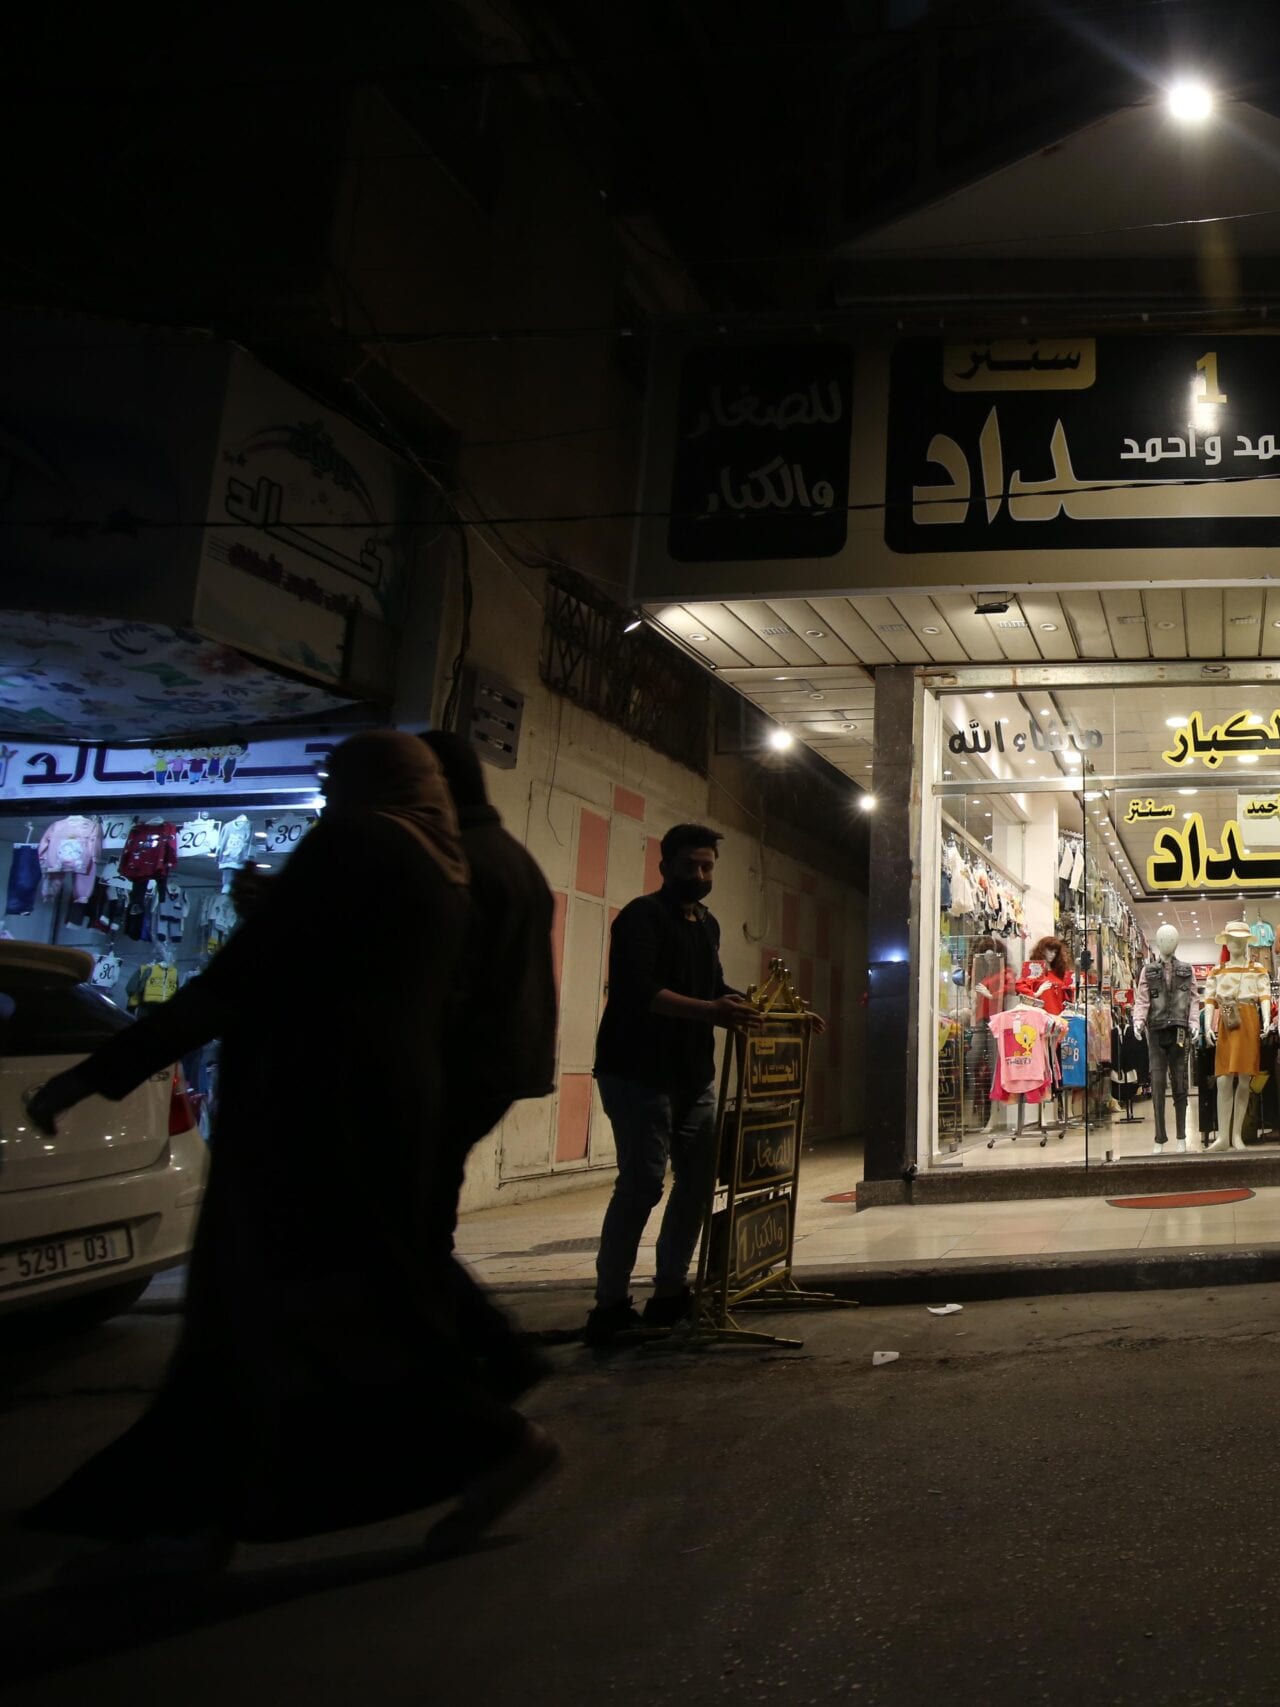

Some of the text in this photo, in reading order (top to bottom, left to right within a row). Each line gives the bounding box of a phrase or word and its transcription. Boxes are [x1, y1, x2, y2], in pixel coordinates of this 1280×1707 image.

[953, 338, 1080, 380] سنتر
[1196, 352, 1227, 403] 1
[686, 377, 842, 440] للصغار
[697, 455, 835, 521] والكبار
[949, 719, 1005, 754] الله
[1128, 802, 1173, 821] سنتر
[179, 831, 207, 850] 20
[275, 824, 302, 844] 30
[1073, 1047, 1080, 1062] 8
[749, 1135, 793, 1177] للصغار
[750, 1215, 784, 1261] والكبار
